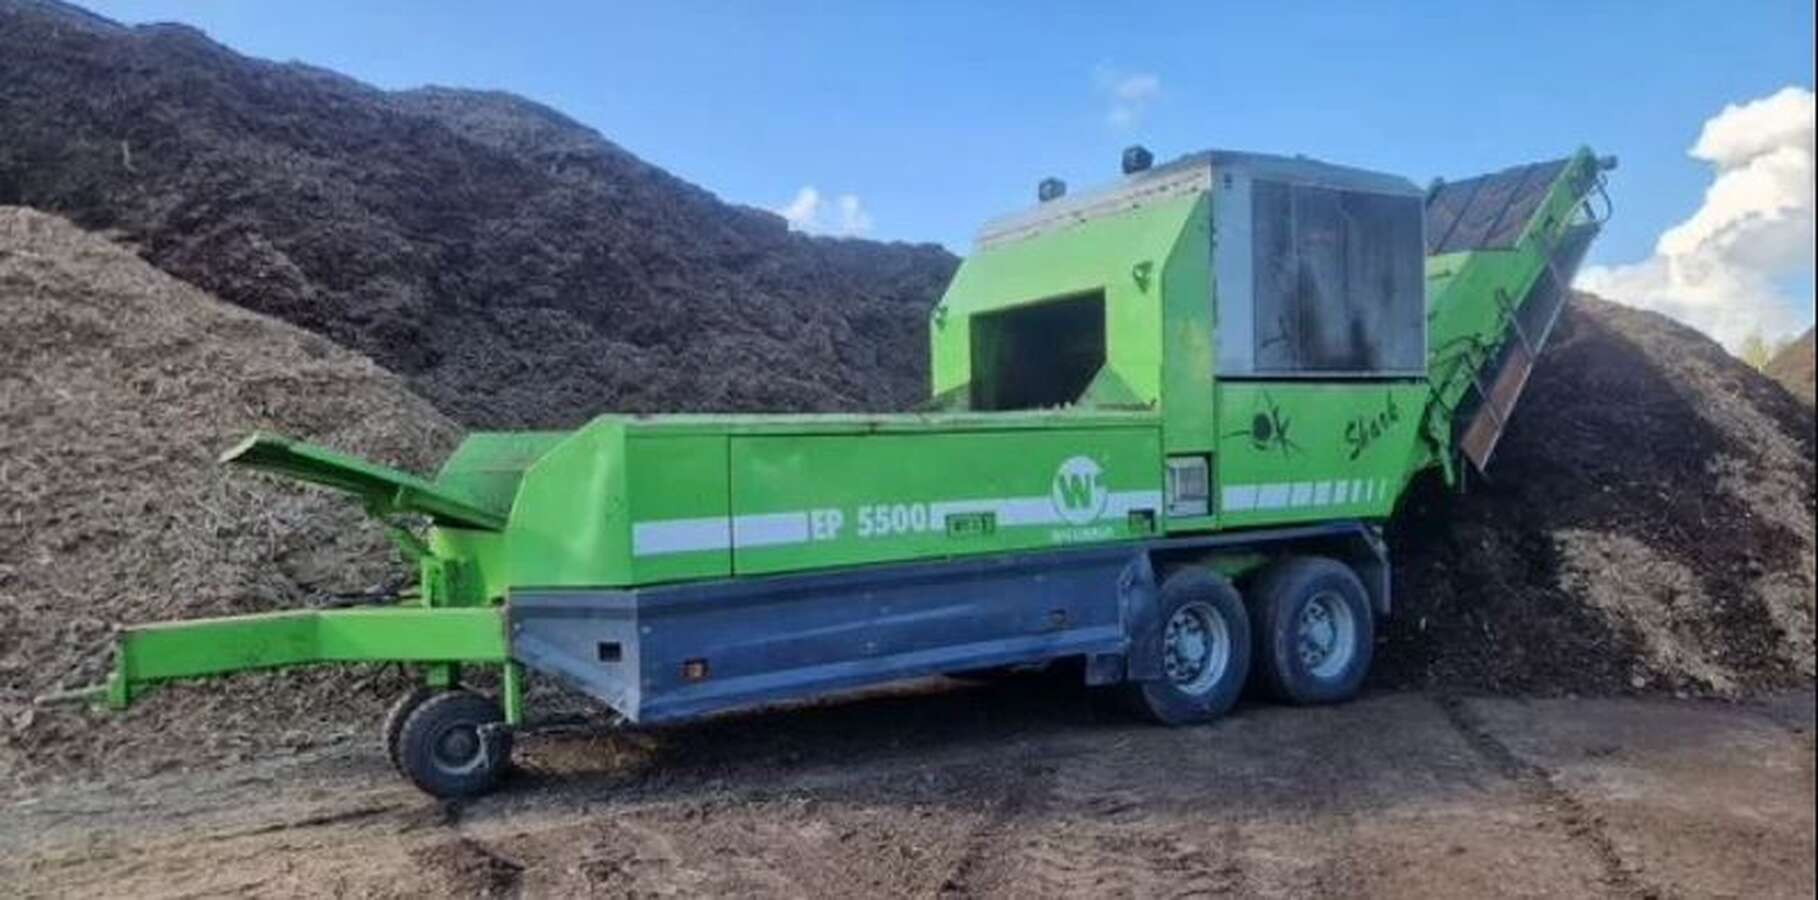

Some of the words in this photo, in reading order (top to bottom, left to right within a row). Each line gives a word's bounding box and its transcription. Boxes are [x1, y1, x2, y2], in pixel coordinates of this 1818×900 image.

[1345, 390, 1399, 461] Shark
[811, 508, 844, 540] EP
[857, 502, 926, 537] 5500
